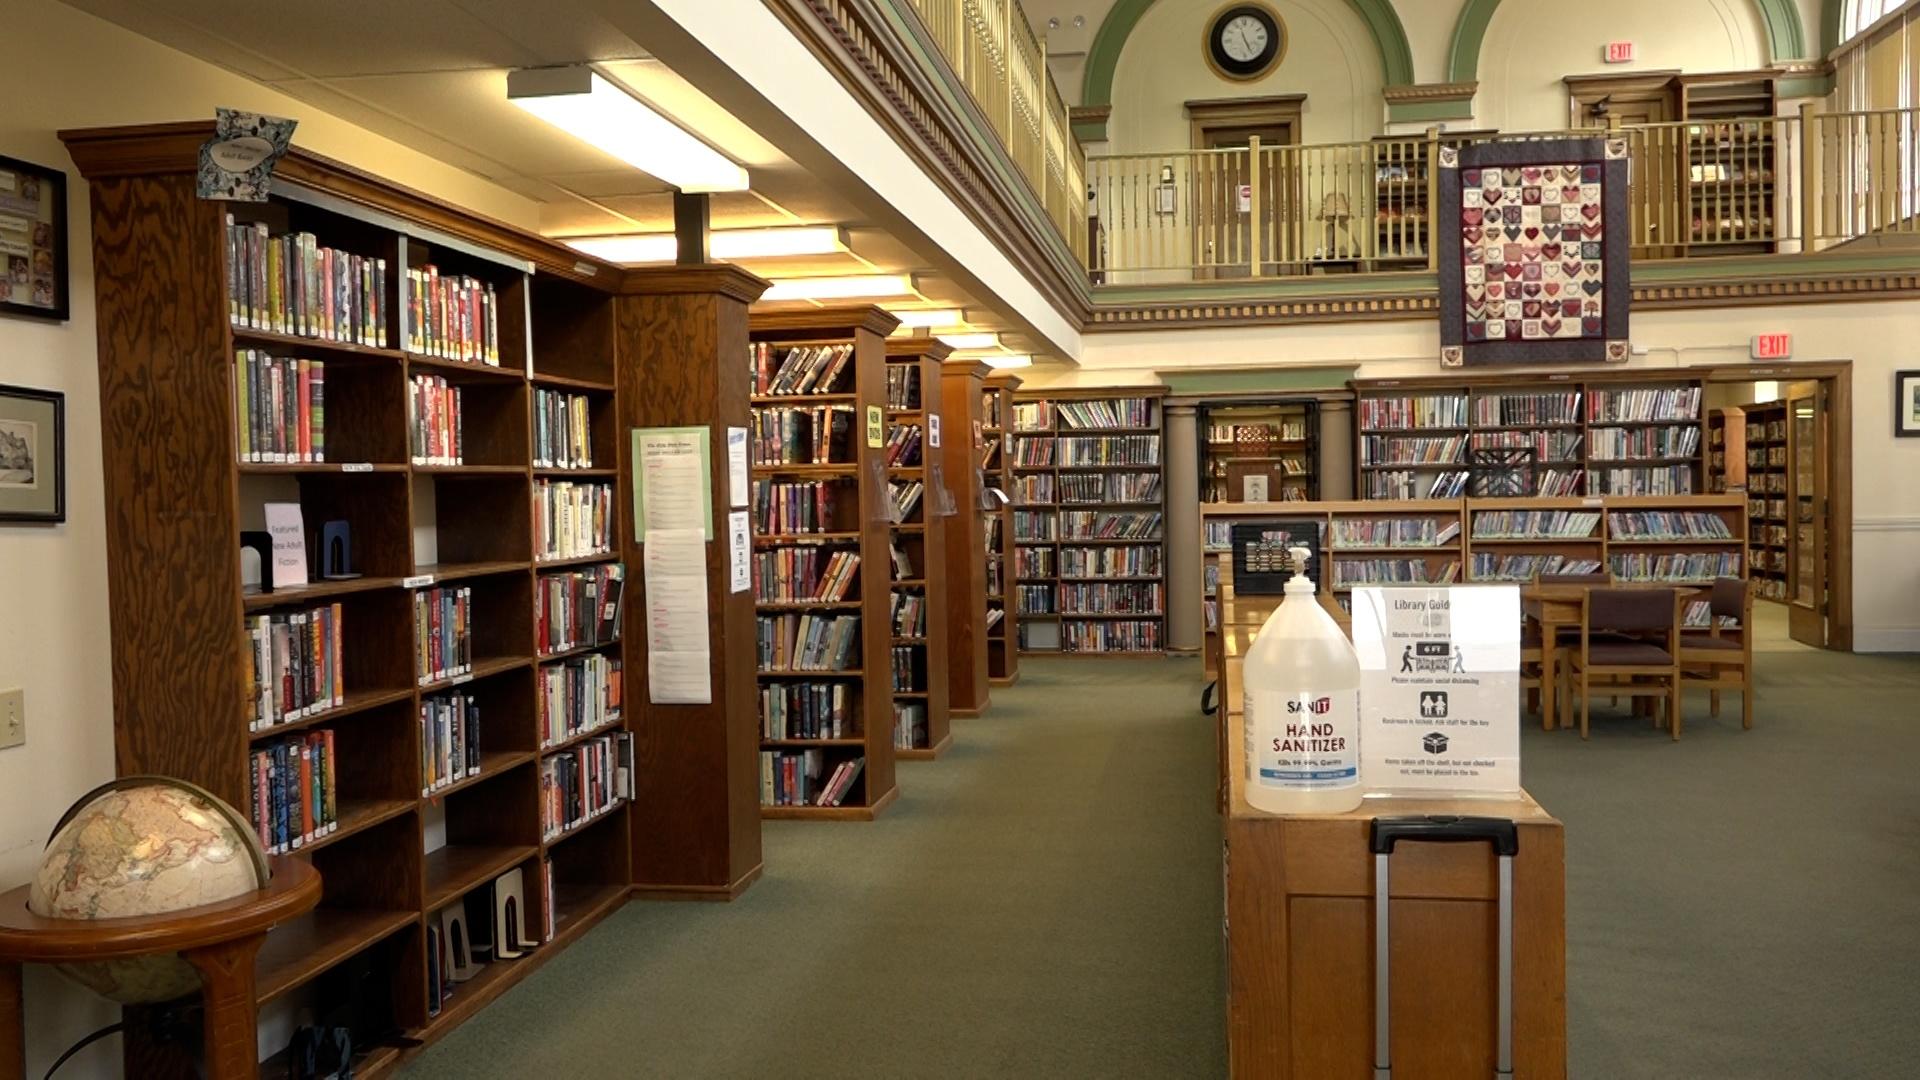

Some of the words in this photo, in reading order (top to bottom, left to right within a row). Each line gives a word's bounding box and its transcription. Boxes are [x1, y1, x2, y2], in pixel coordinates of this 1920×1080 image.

[1610, 43, 1632, 59] EXIT
[1759, 335, 1788, 356] EXIT
[1394, 599, 1426, 611] Library
[1286, 723, 1334, 737] HAND
[1273, 737, 1346, 752] SANITIZER
